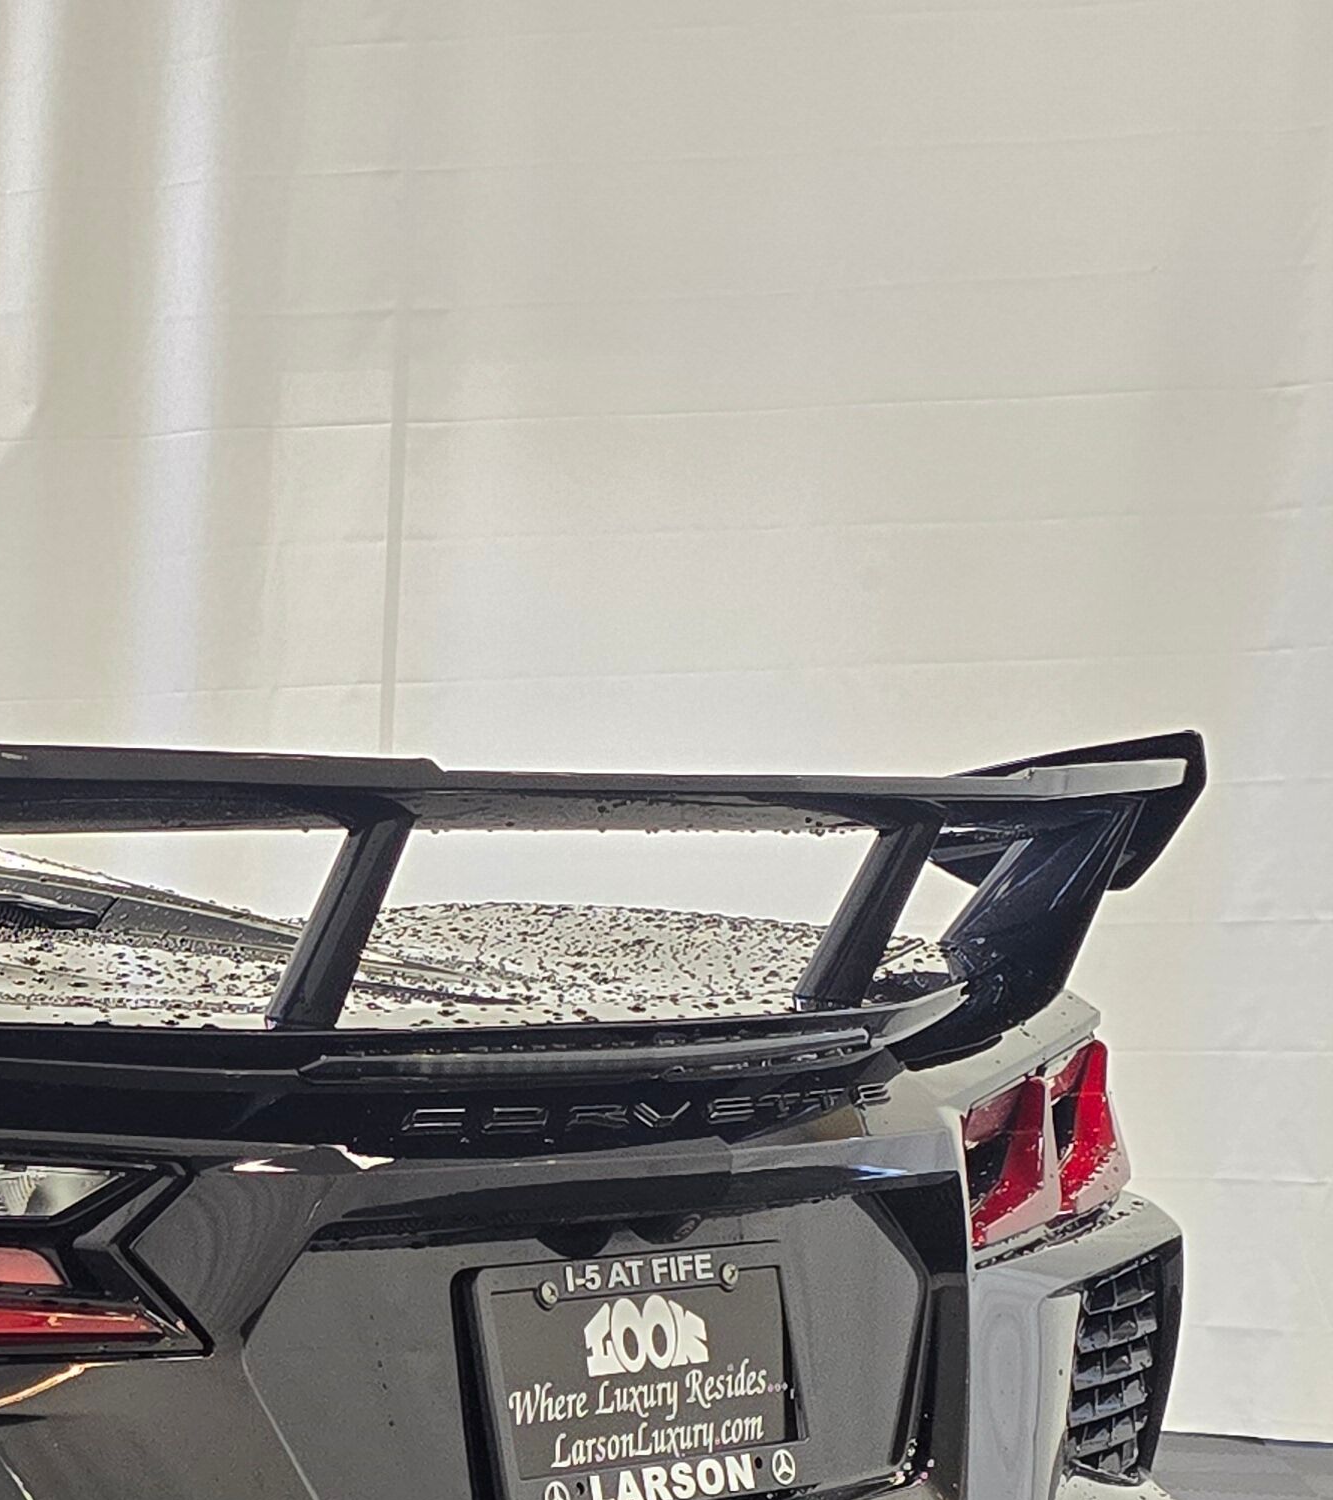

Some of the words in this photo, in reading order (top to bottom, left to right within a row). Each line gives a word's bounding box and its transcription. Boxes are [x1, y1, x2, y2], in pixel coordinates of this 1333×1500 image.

[402, 1083, 891, 1134] CORVETTE
[565, 1264, 602, 1293] I-5
[608, 1258, 645, 1288] AT
[651, 1253, 716, 1285] FIFE
[584, 1294, 709, 1378] LOOK
[508, 1385, 589, 1426] Where
[594, 1378, 680, 1421] Luxury
[550, 1413, 765, 1469] LarsonLuxury.com
